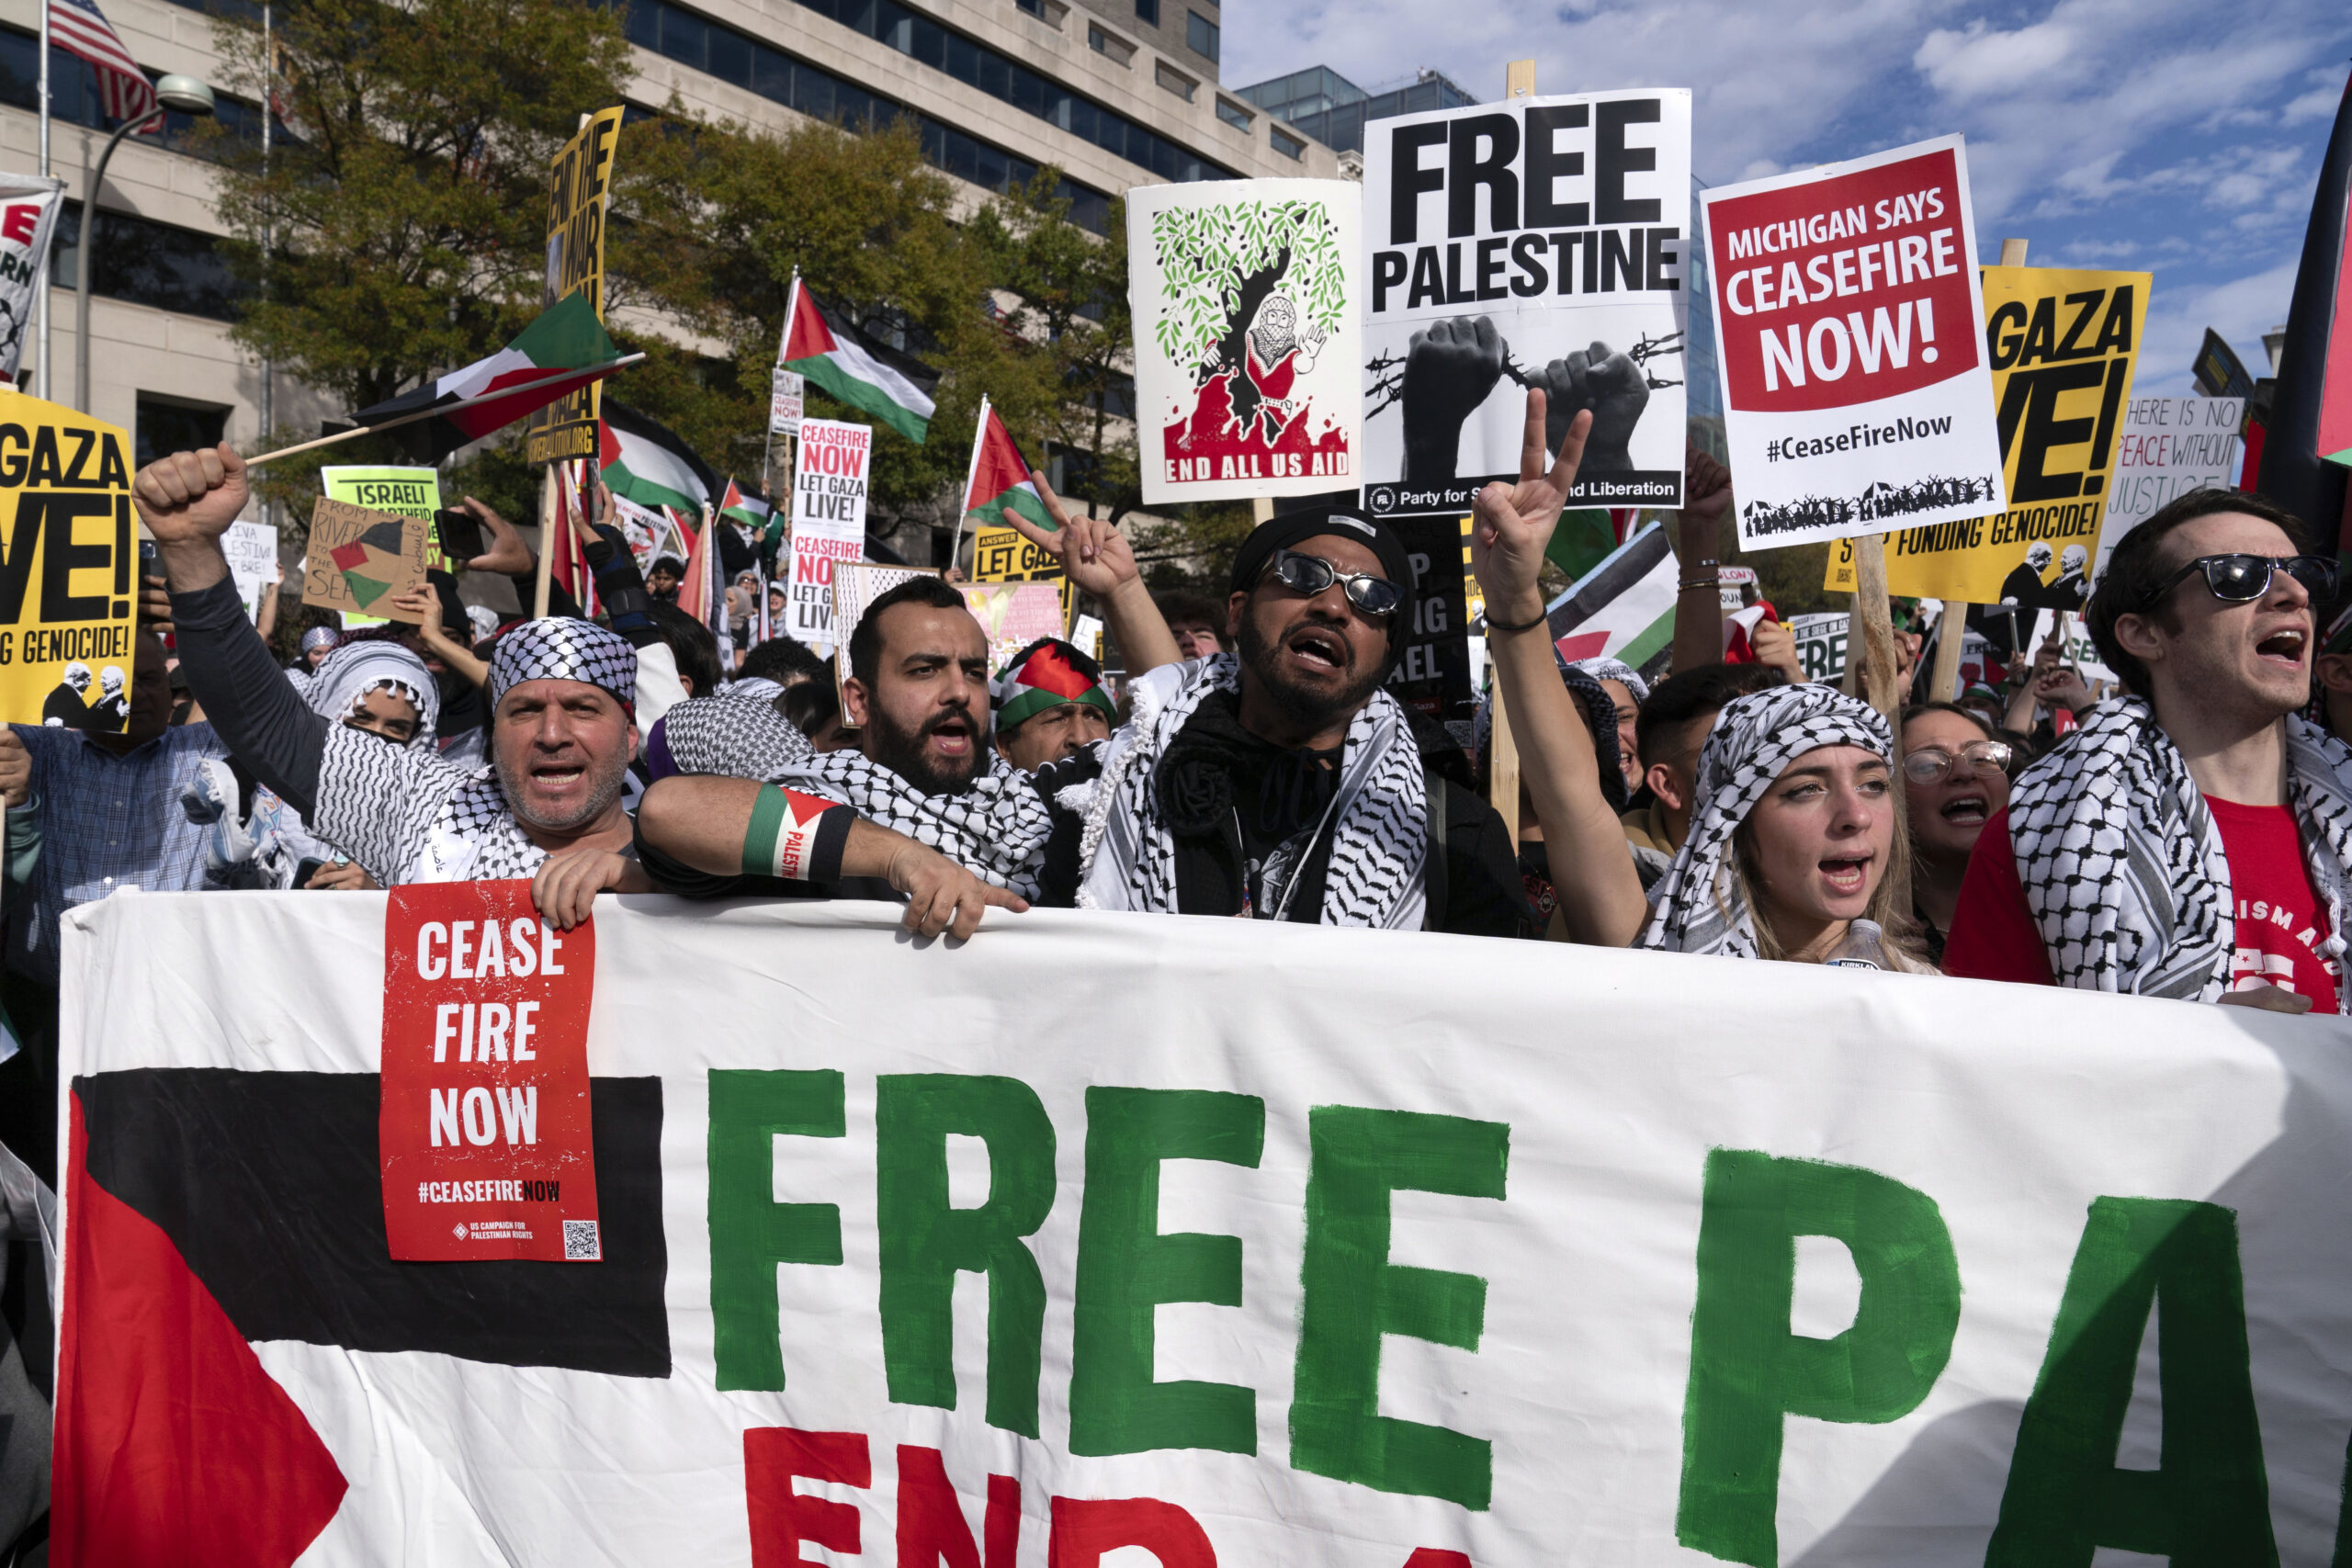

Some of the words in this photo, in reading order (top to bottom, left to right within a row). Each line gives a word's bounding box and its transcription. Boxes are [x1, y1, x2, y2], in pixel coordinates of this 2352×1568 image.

[549, 150, 576, 233] END
[576, 118, 615, 211] THE
[1390, 98, 1661, 245] FREE
[1727, 205, 1867, 260] MICHIGAN
[1875, 187, 1945, 230] SAYS
[565, 200, 600, 290] WAR
[1372, 227, 1680, 313] PALESTINE
[1726, 227, 1959, 317] CEASEFIRE
[1986, 284, 2133, 371] GAZA
[1760, 297, 1939, 392] NOW!
[2178, 400, 2195, 425] IS
[2205, 400, 2236, 427] NO
[801, 424, 869, 448] CEASEFIRE
[1767, 414, 1952, 465] #CeaseFireNow
[2172, 434, 2238, 467] WITHOUT
[0, 423, 130, 490] GAZA
[804, 443, 864, 478] NOW
[1166, 457, 1211, 481] END
[1221, 455, 1261, 479] ALL
[1272, 453, 1302, 477] US
[1311, 452, 1348, 475] AID
[356, 484, 425, 504] ISRAELI
[800, 474, 824, 491] LET
[829, 477, 865, 497] GAZA
[1400, 491, 1438, 506] Party
[1444, 489, 1467, 502] for
[1569, 482, 1585, 497] nd
[1590, 481, 1674, 497] Liberation
[319, 499, 368, 521] FROM
[806, 493, 855, 522] LIVE!
[227, 525, 257, 539] IVA
[314, 512, 364, 551] RIVER
[981, 535, 1015, 546] ANSWER
[1897, 517, 1984, 556] FUNDING
[1990, 502, 2099, 546] GENOCIDE!
[0, 491, 130, 625] VE!
[310, 556, 333, 568] THE
[795, 536, 862, 559] CEASEFIRE
[977, 547, 1015, 576] LET
[1022, 544, 1058, 570] GAZ
[308, 570, 355, 600] SEA
[797, 554, 836, 585] NO
[794, 584, 818, 602] LET
[798, 604, 832, 630] LIV
[1839, 618, 1849, 630] GAZ
[23, 626, 129, 663] GENOCIDE!
[417, 917, 564, 980] CEASE
[1841, 962, 1873, 970] KIRKLA
[434, 1000, 540, 1063] FIRE
[430, 1086, 537, 1147] NOW
[418, 1179, 560, 1203] #CEASEFIRENOW
[470, 1230, 511, 1239] PALESTINIAN
[513, 1230, 533, 1239] RIGHTS
[481, 1222, 514, 1230] CAMPAIGN
[707, 1068, 1510, 1511] FREE
